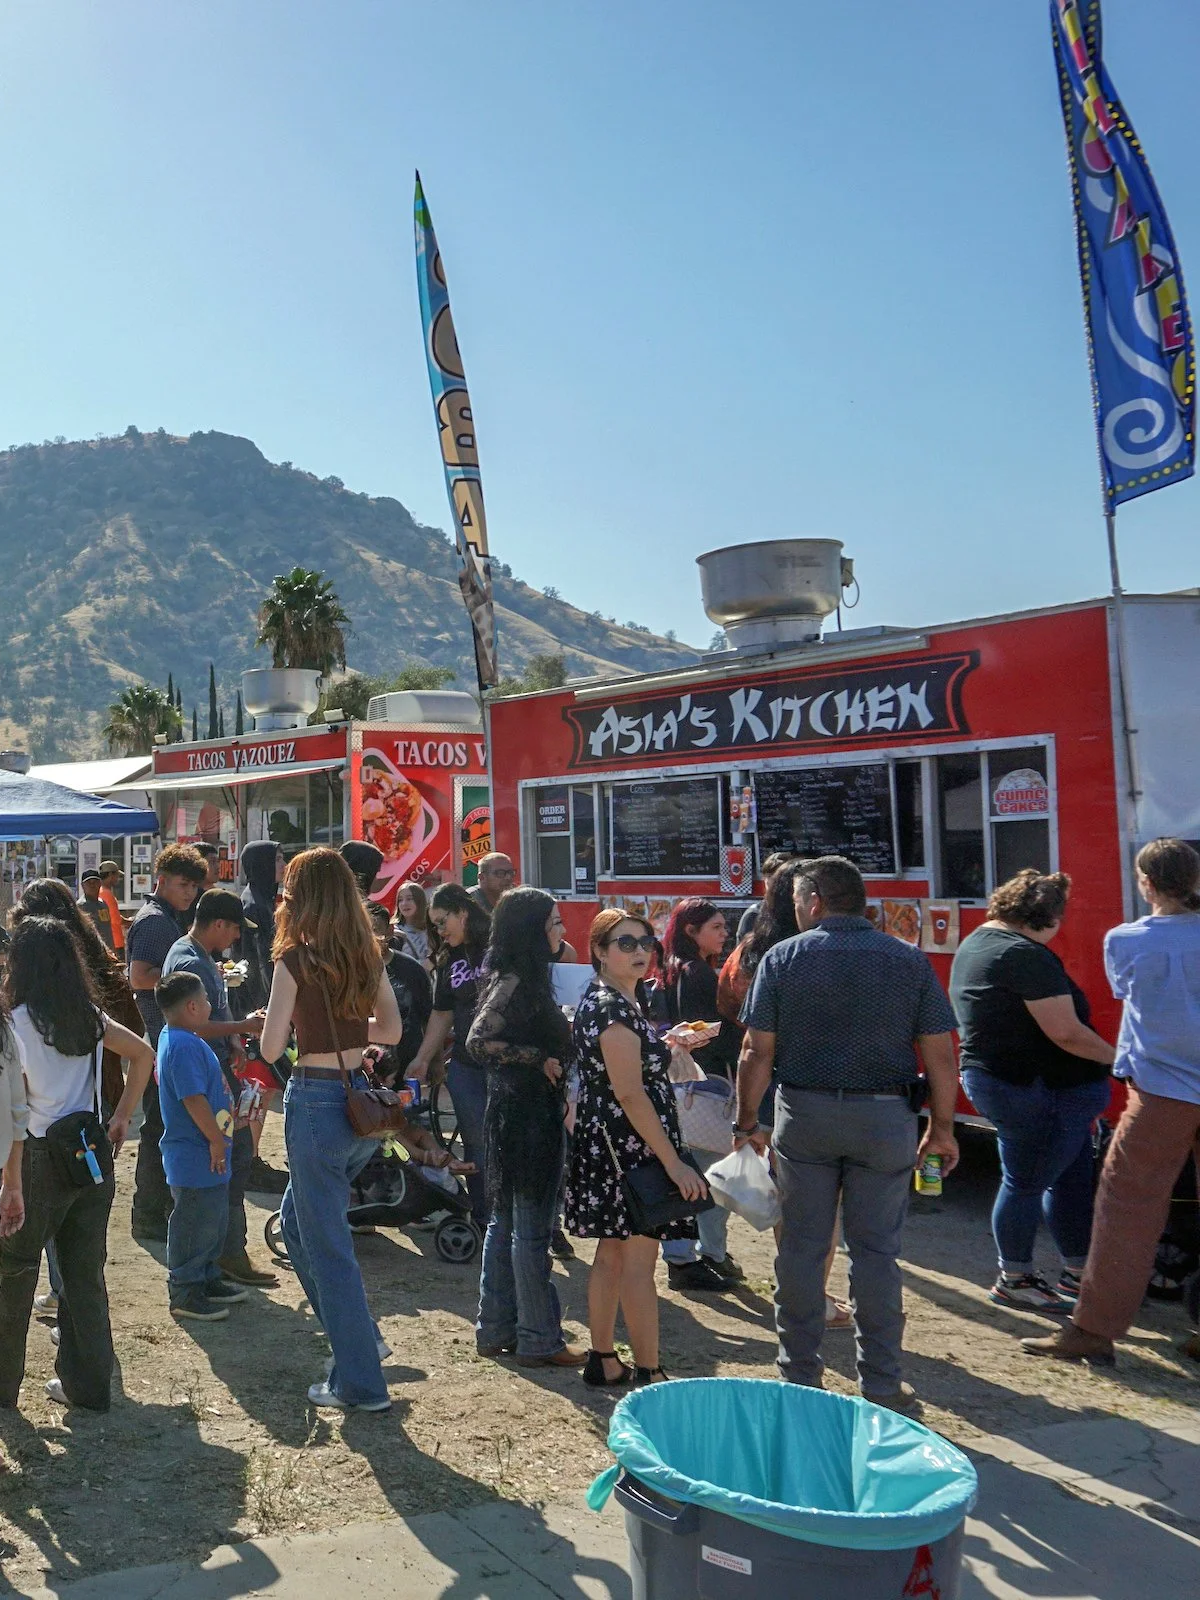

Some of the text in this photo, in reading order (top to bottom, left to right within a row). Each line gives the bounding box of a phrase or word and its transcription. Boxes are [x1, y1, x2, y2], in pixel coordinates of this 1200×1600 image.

[588, 680, 935, 757] ASIA'S KITCHEN
[187, 751, 226, 770] TACOS
[393, 741, 468, 766] TACOS
[539, 805, 566, 816] ORDER
[463, 840, 492, 857] VAZQ
